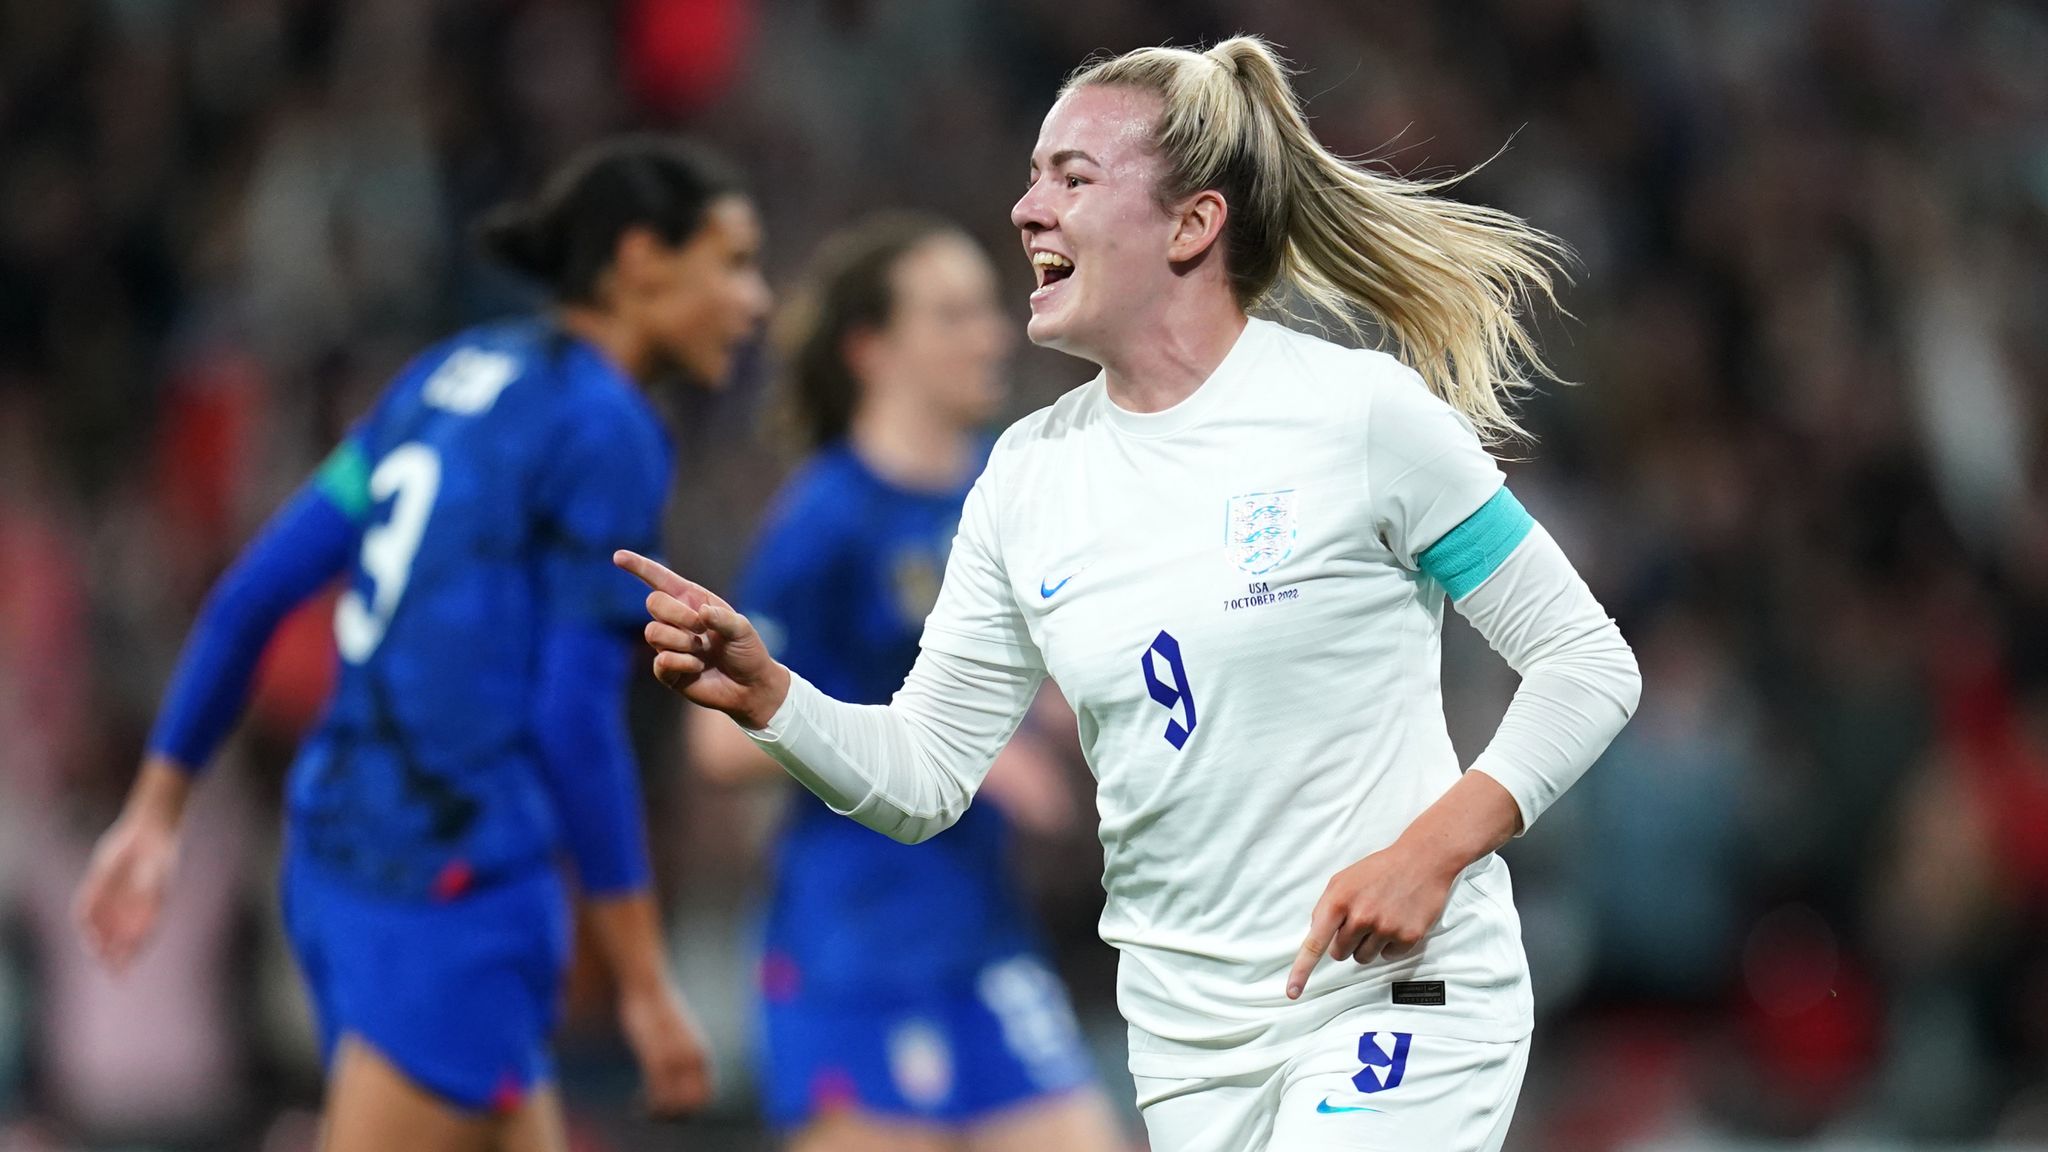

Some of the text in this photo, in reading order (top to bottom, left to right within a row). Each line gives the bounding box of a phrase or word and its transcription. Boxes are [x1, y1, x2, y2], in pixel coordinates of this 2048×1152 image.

[334, 442, 442, 664] 3
[1223, 588, 1299, 612] 7 OCTOBER 2022
[1248, 582, 1269, 594] USA
[1141, 629, 1197, 751] 9
[1351, 1031, 1413, 1094] 9
